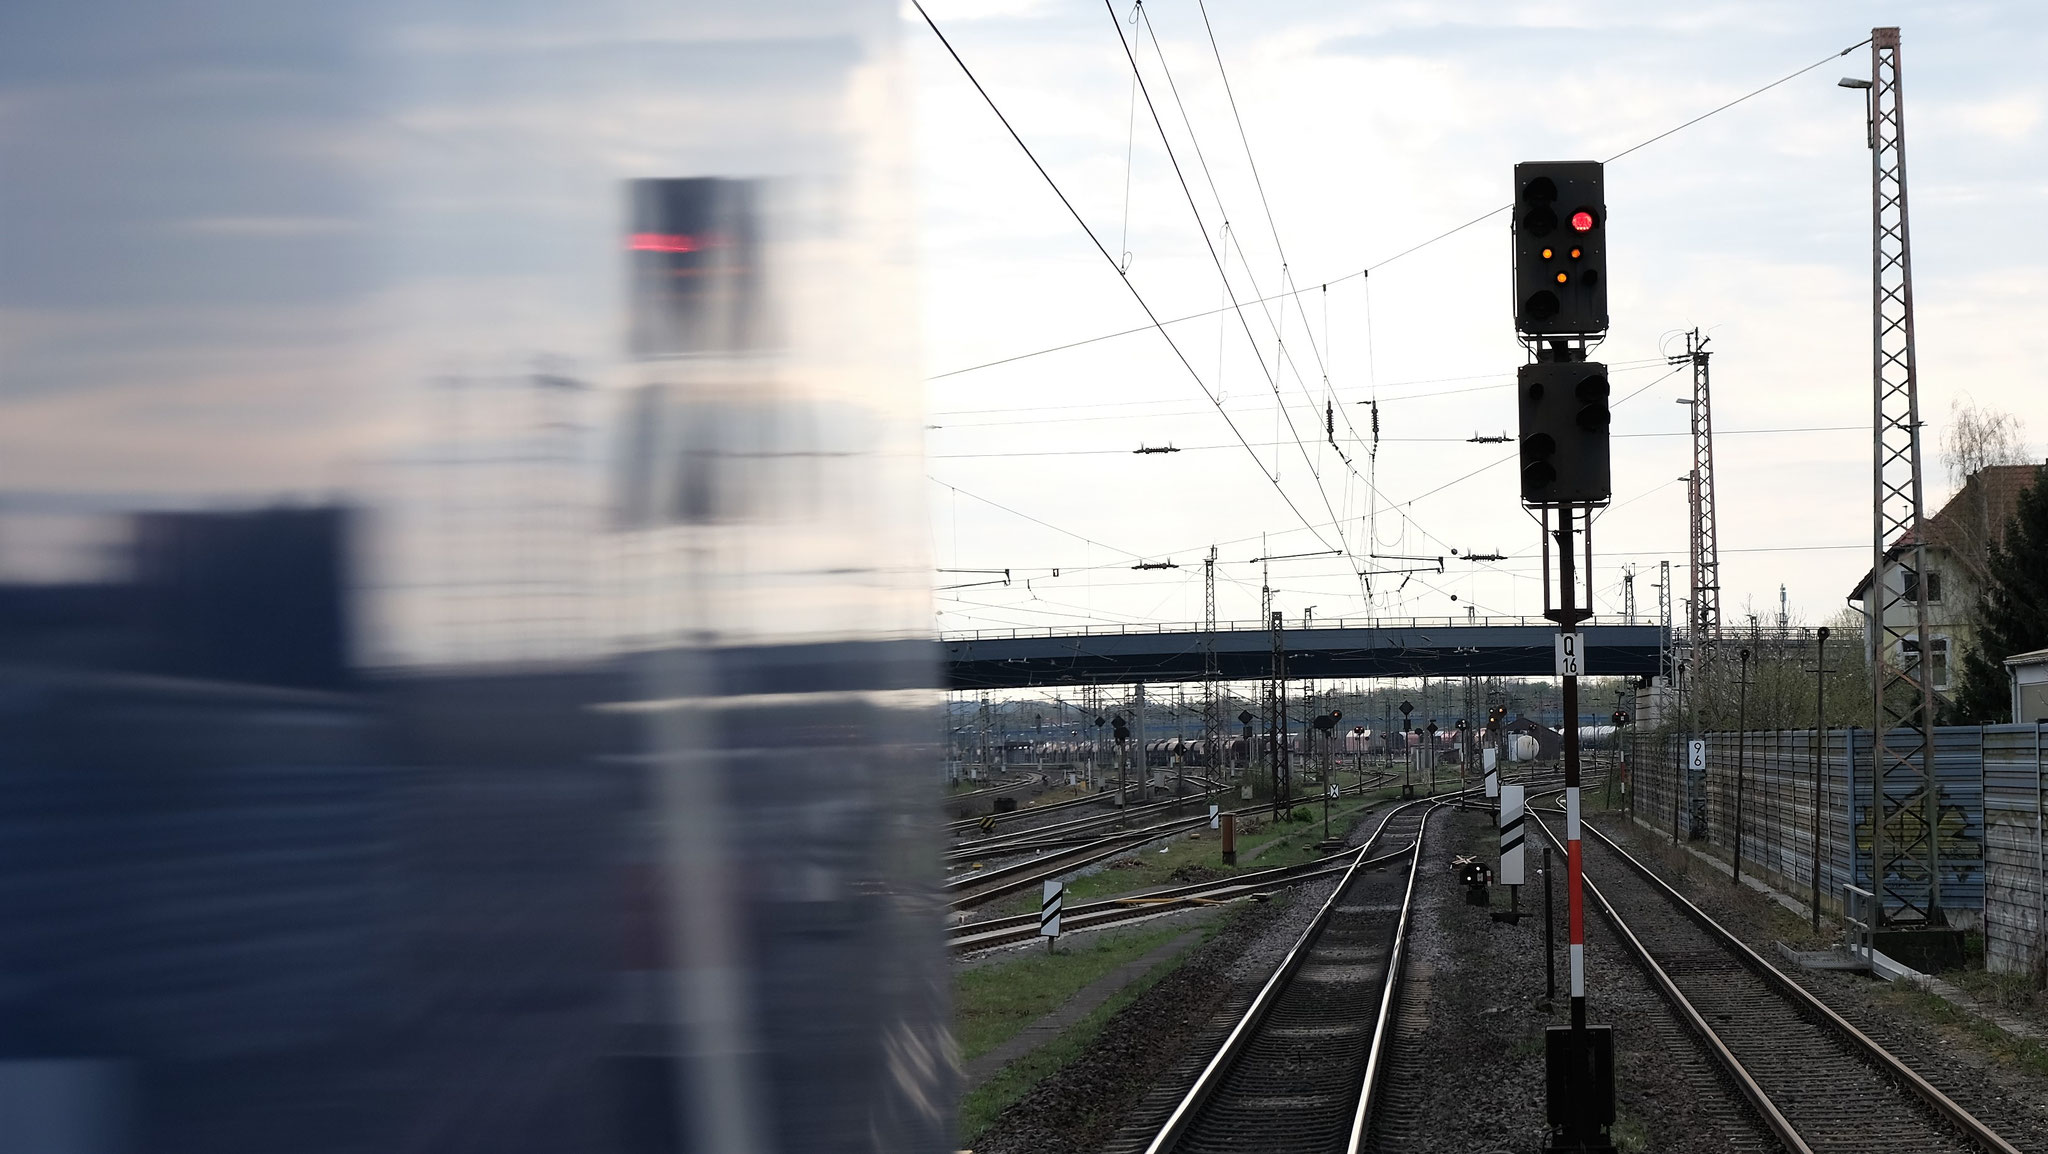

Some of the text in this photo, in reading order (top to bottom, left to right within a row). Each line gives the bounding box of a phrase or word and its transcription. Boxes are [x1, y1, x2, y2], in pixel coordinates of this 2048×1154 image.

[1563, 635, 1575, 657] Q
[1562, 657, 1577, 673] 16
[1693, 742, 1702, 754] 9
[1694, 755, 1702, 767] 6
